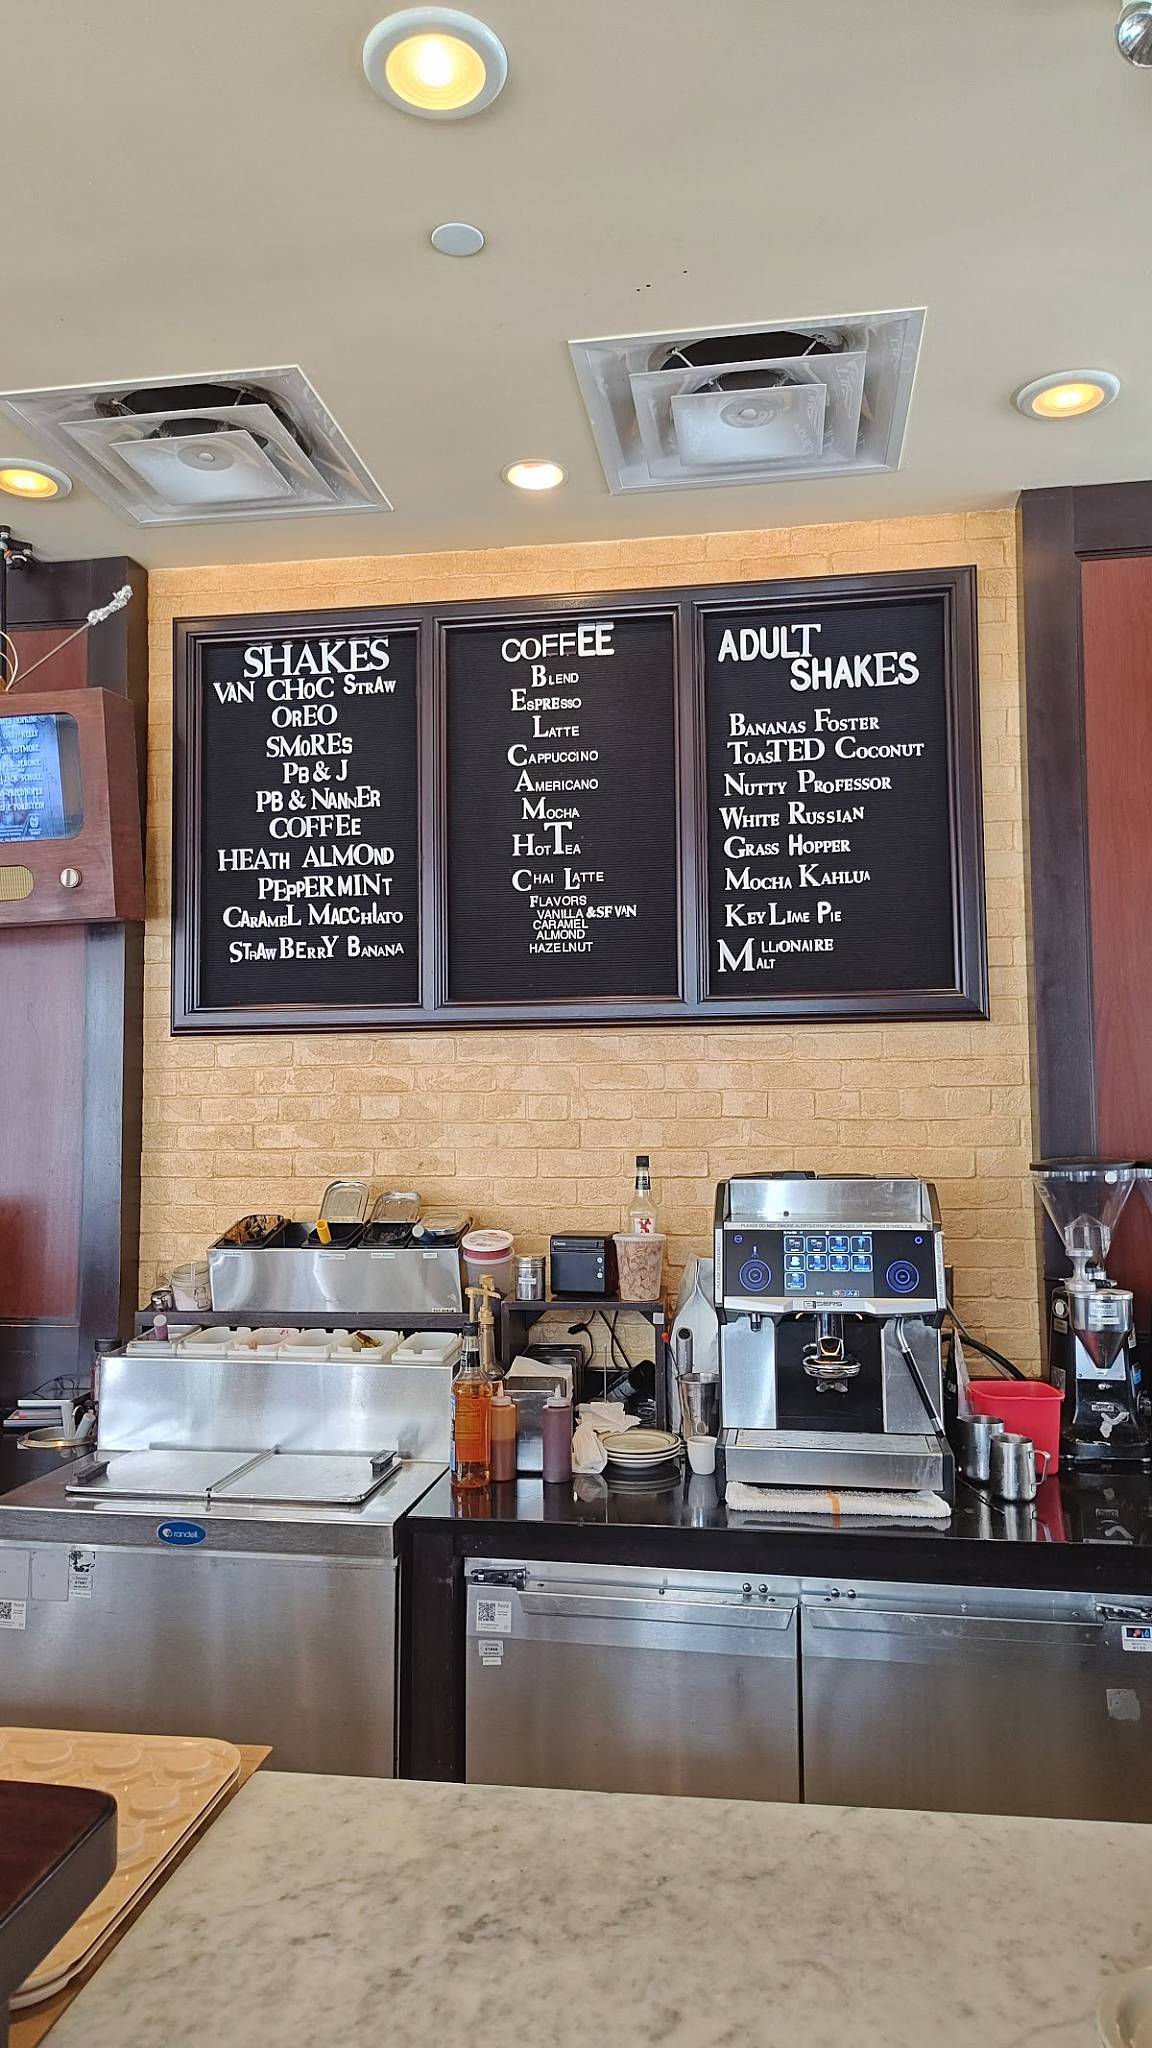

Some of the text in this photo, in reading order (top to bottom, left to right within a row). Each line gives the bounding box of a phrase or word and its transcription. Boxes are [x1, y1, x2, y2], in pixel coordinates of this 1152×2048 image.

[501, 622, 615, 663] COFFEE
[718, 623, 822, 663] ADULT
[243, 638, 390, 678] SHAKES
[530, 664, 580, 688] BLEND
[790, 651, 920, 692] SHAKES
[213, 673, 397, 704] VAN CHOC STRAW
[510, 688, 582, 712] ESPRESSO
[271, 704, 338, 728] OREO
[532, 715, 580, 738] LATTE
[729, 708, 880, 737] BANANAS FOSTER
[266, 732, 353, 758] SMORES
[507, 743, 599, 767] CAPPUCCINO
[726, 735, 925, 766] TOASTED COCONUT
[283, 759, 349, 784] PB & J
[514, 769, 599, 793] AMERICANO
[723, 769, 892, 797] NUTTY PROFESSOR
[256, 785, 381, 813] PB & NANNER
[521, 796, 580, 820] MOCHA
[269, 814, 362, 839] COFFEE
[719, 800, 865, 830] WHITE RUSSIAN
[217, 843, 395, 872] HEATH ALMOND
[723, 833, 851, 859] GRASS HOPPER
[257, 873, 393, 902] PEPPERMINT
[511, 867, 605, 892] CHAI LATTE
[724, 863, 871, 891] MOCHA KAHLUA
[529, 895, 588, 908] FLAVORS
[537, 909, 584, 919] VANILLA
[724, 901, 842, 927] KEY LIME PIE
[222, 904, 302, 929] CARAMEL
[532, 918, 589, 931] CARAMEL
[347, 935, 405, 958] BANANA
[536, 929, 586, 940] ALMOND
[529, 941, 594, 954] HAZELNUT
